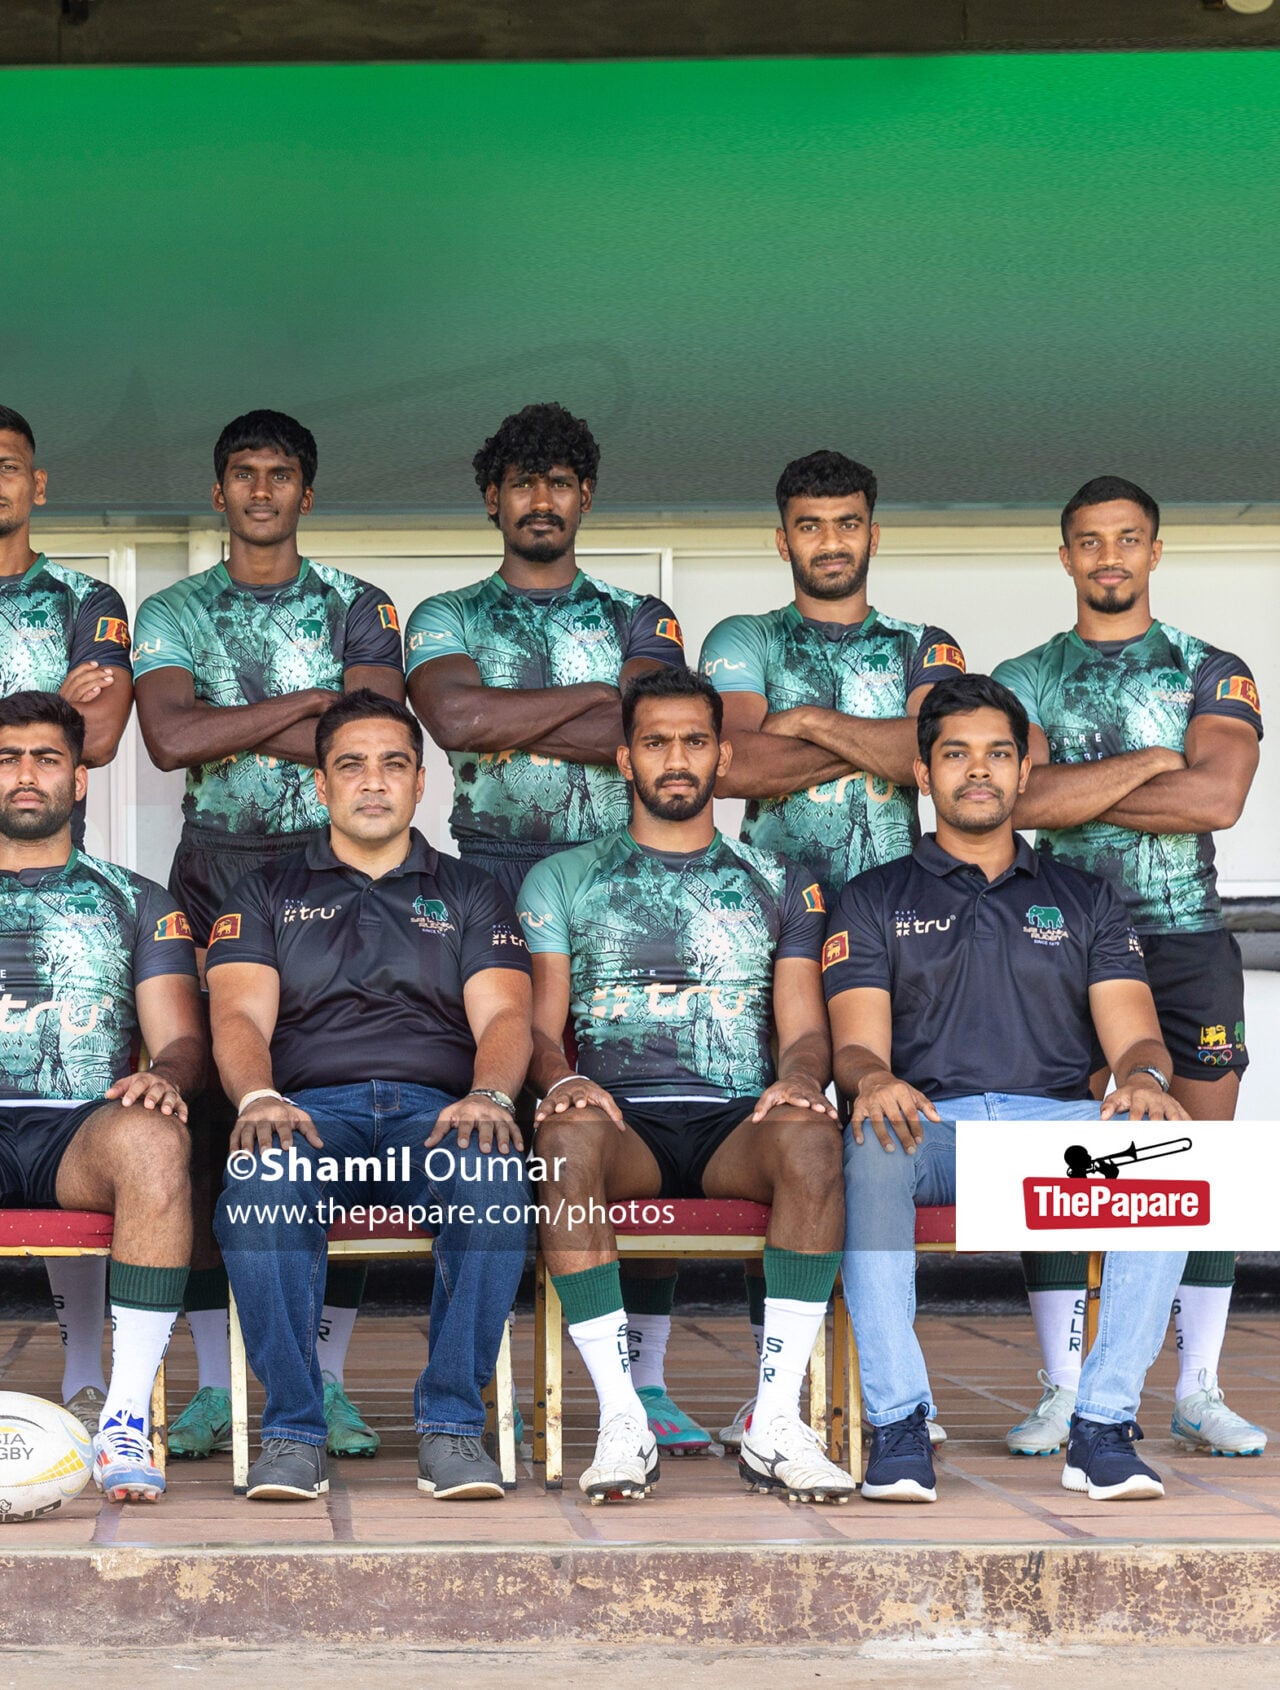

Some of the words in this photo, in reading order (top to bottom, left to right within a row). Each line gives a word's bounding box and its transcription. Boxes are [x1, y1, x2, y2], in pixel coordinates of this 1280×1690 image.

[299, 906, 336, 921] tru
[913, 918, 951, 934] tru
[643, 983, 747, 1019] tru
[1069, 1299, 1086, 1352] SLR
[617, 1323, 630, 1374] SLR
